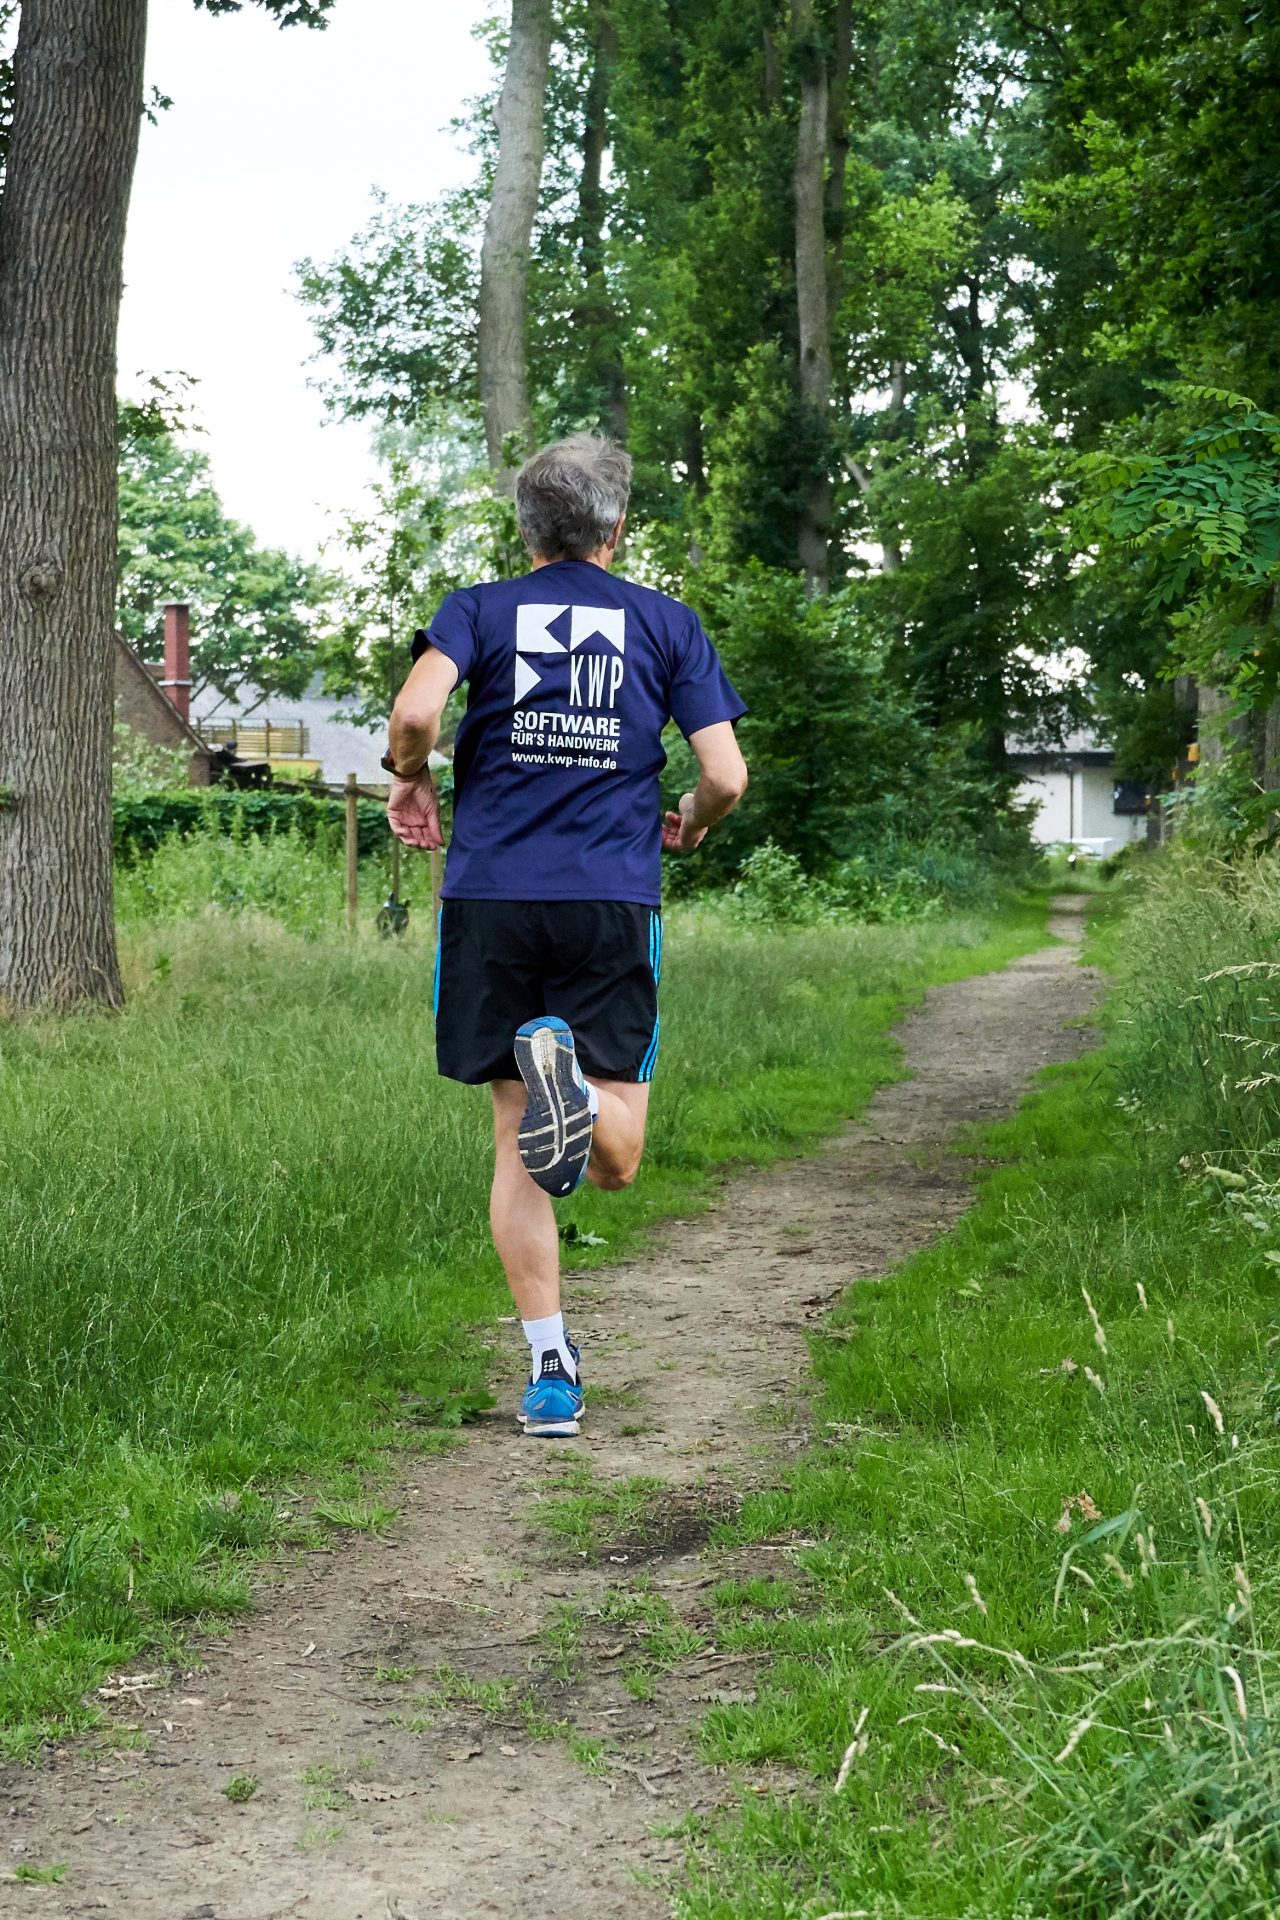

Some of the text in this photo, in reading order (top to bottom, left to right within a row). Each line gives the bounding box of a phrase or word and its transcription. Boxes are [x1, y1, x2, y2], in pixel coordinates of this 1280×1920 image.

[569, 654, 624, 709] KWP
[512, 711, 621, 737] SOFTWARE
[547, 734, 620, 752] HANDWERK
[511, 752, 617, 770] www.kwp-info.de
